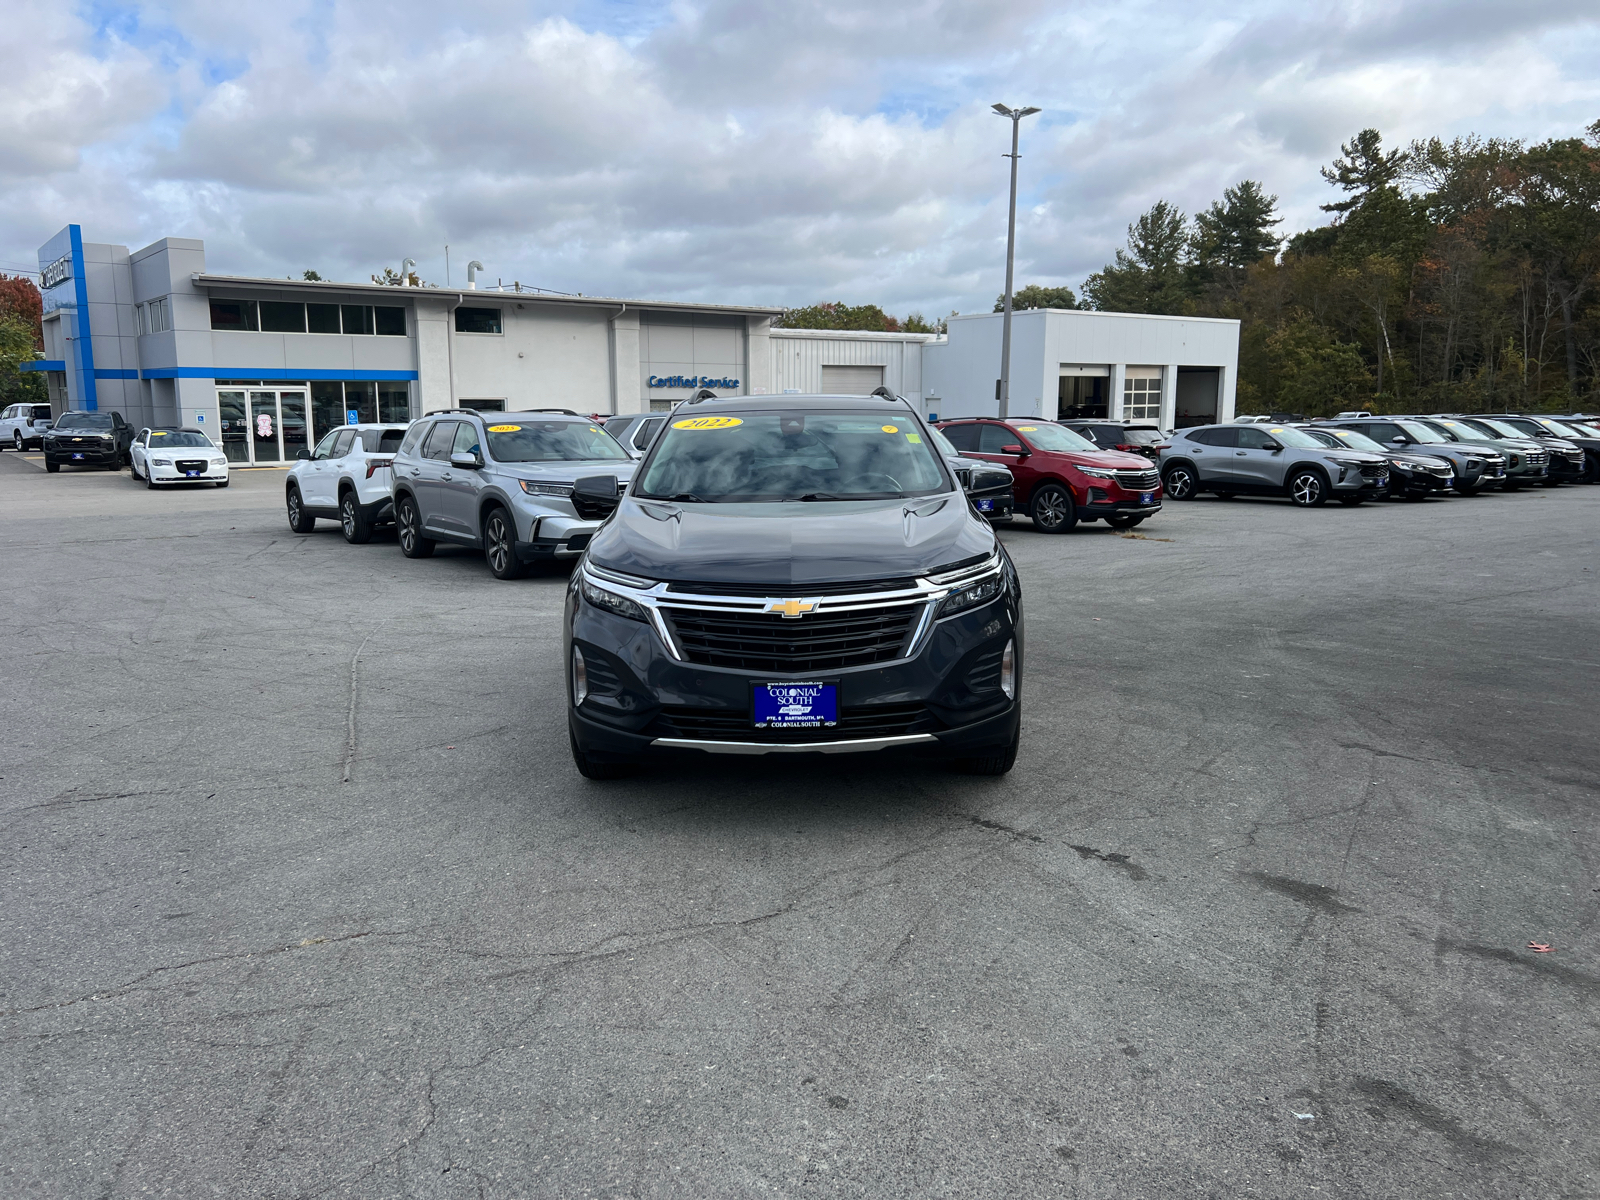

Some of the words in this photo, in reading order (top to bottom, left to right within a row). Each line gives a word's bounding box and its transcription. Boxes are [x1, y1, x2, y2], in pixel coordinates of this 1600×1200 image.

[648, 375, 698, 388] Certified
[701, 376, 740, 388] Service
[682, 418, 732, 429] 2022
[769, 688, 821, 697] COLONIAL
[777, 696, 813, 705] SOUTH
